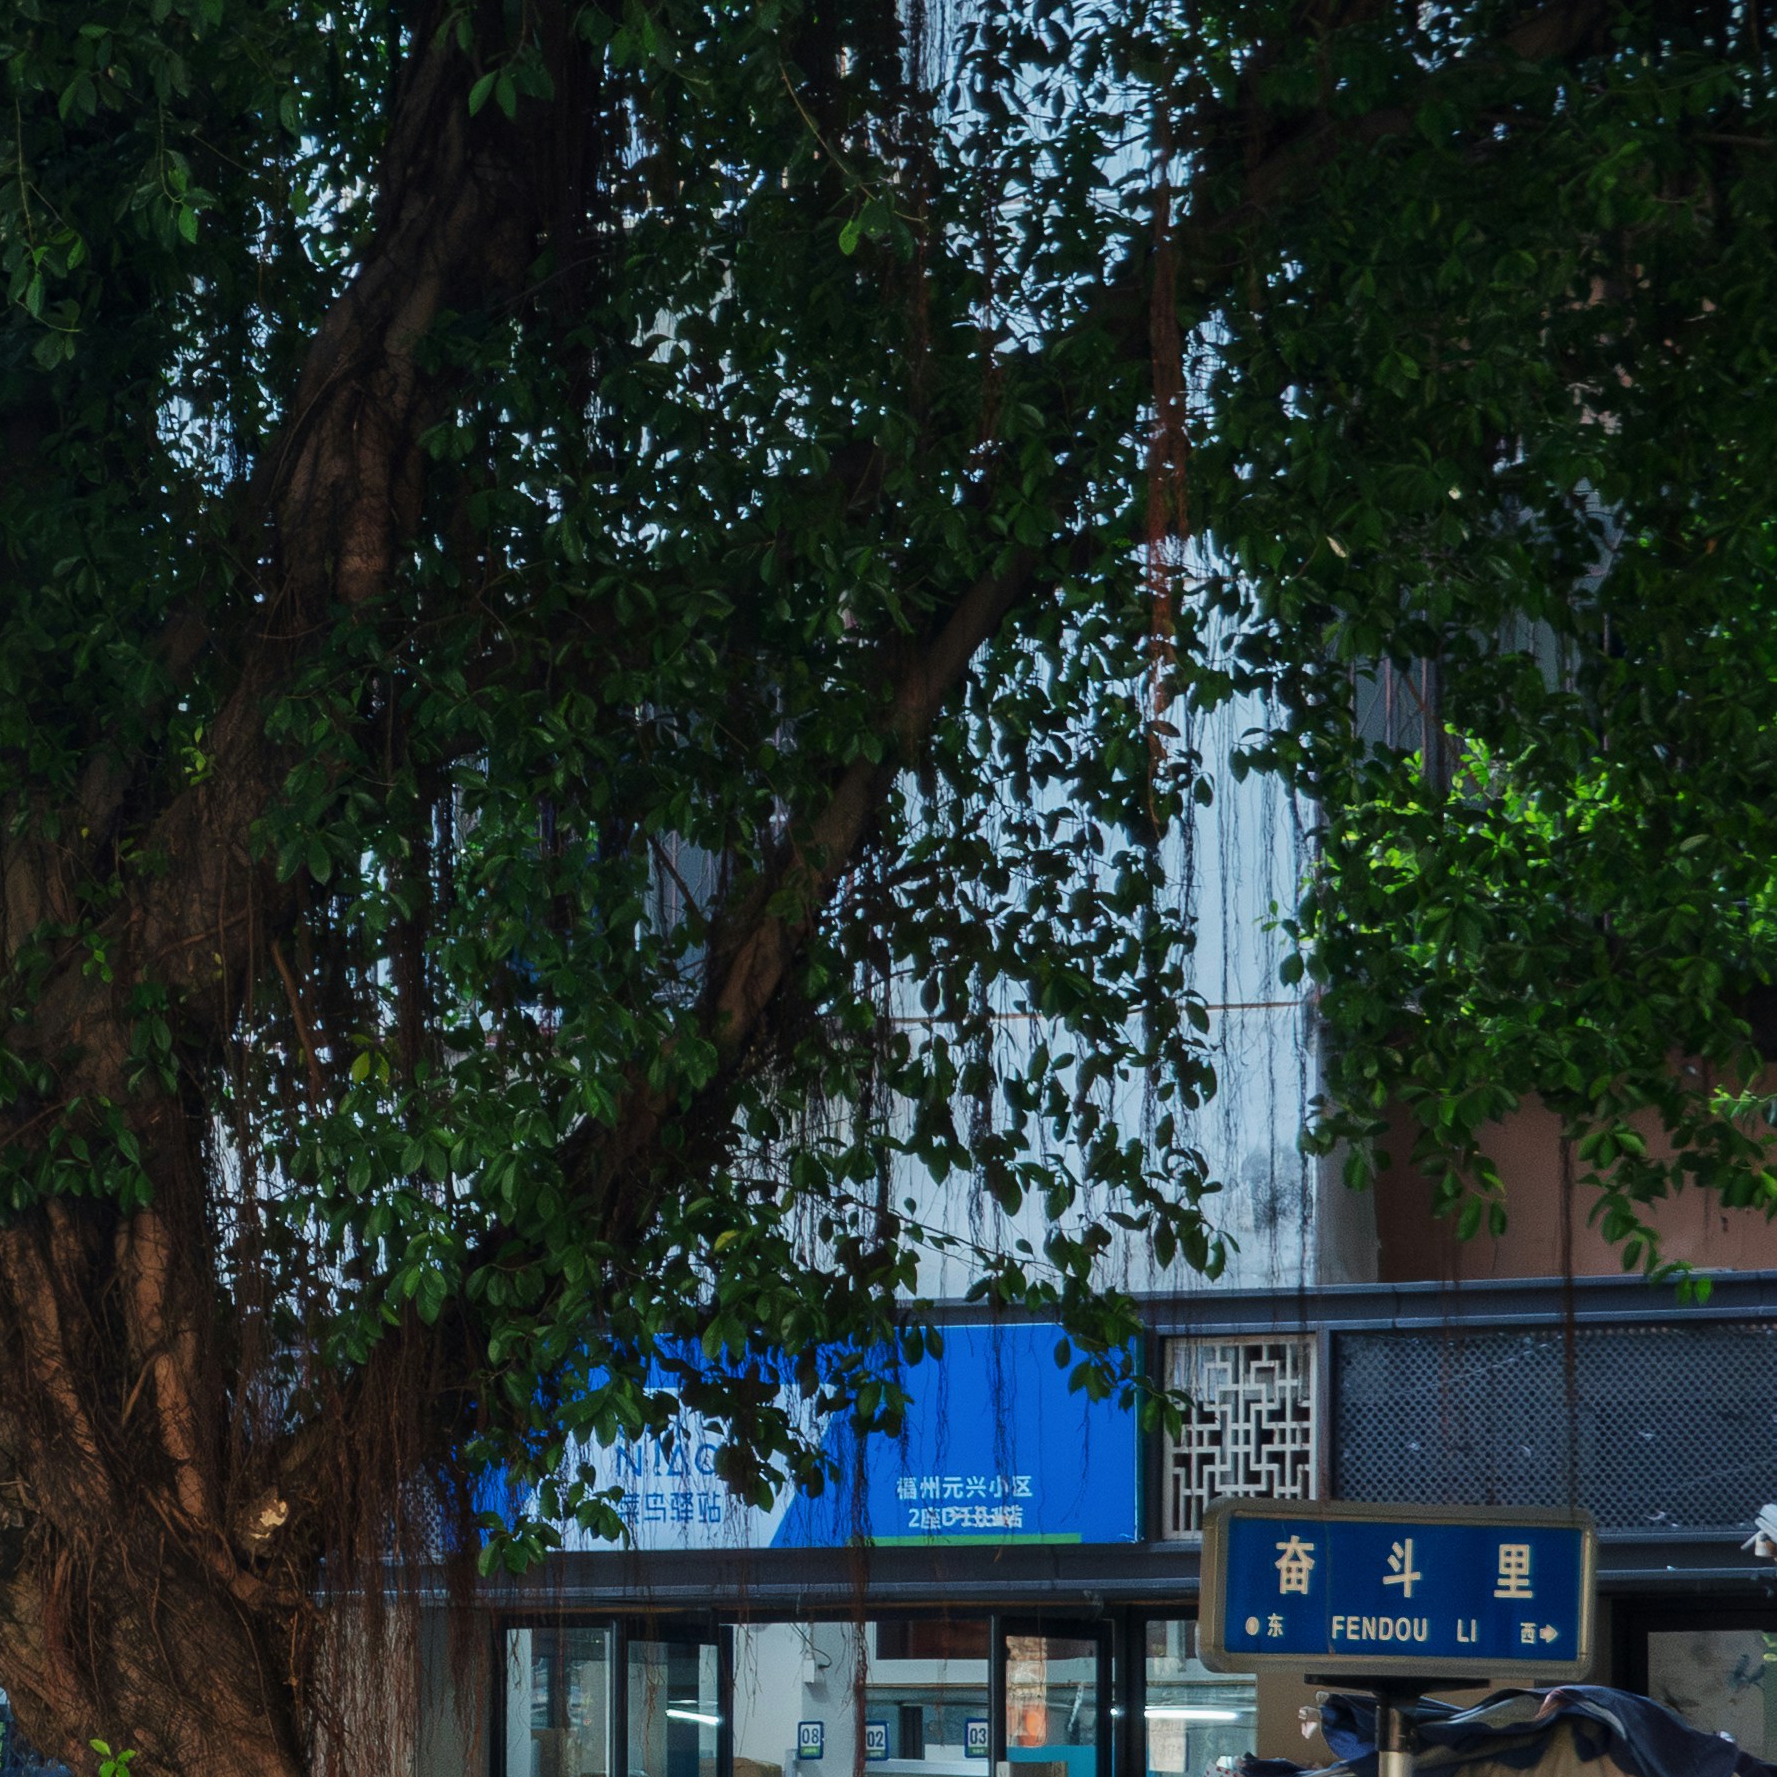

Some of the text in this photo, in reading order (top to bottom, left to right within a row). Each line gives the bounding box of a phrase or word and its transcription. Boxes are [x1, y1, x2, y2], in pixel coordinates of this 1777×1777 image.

[896, 1475, 1033, 1500] 福州元兴小区
[618, 1492, 721, 1524] 菜鸟驿站
[1275, 1535, 1533, 1598] 奋斗里
[1267, 1613, 1284, 1637] 东
[1332, 1616, 1477, 1643] FENDOU LI
[1520, 1623, 1536, 1644] 西
[801, 1727, 820, 1744] 08
[867, 1730, 885, 1748] 02
[969, 1727, 987, 1745] 03
